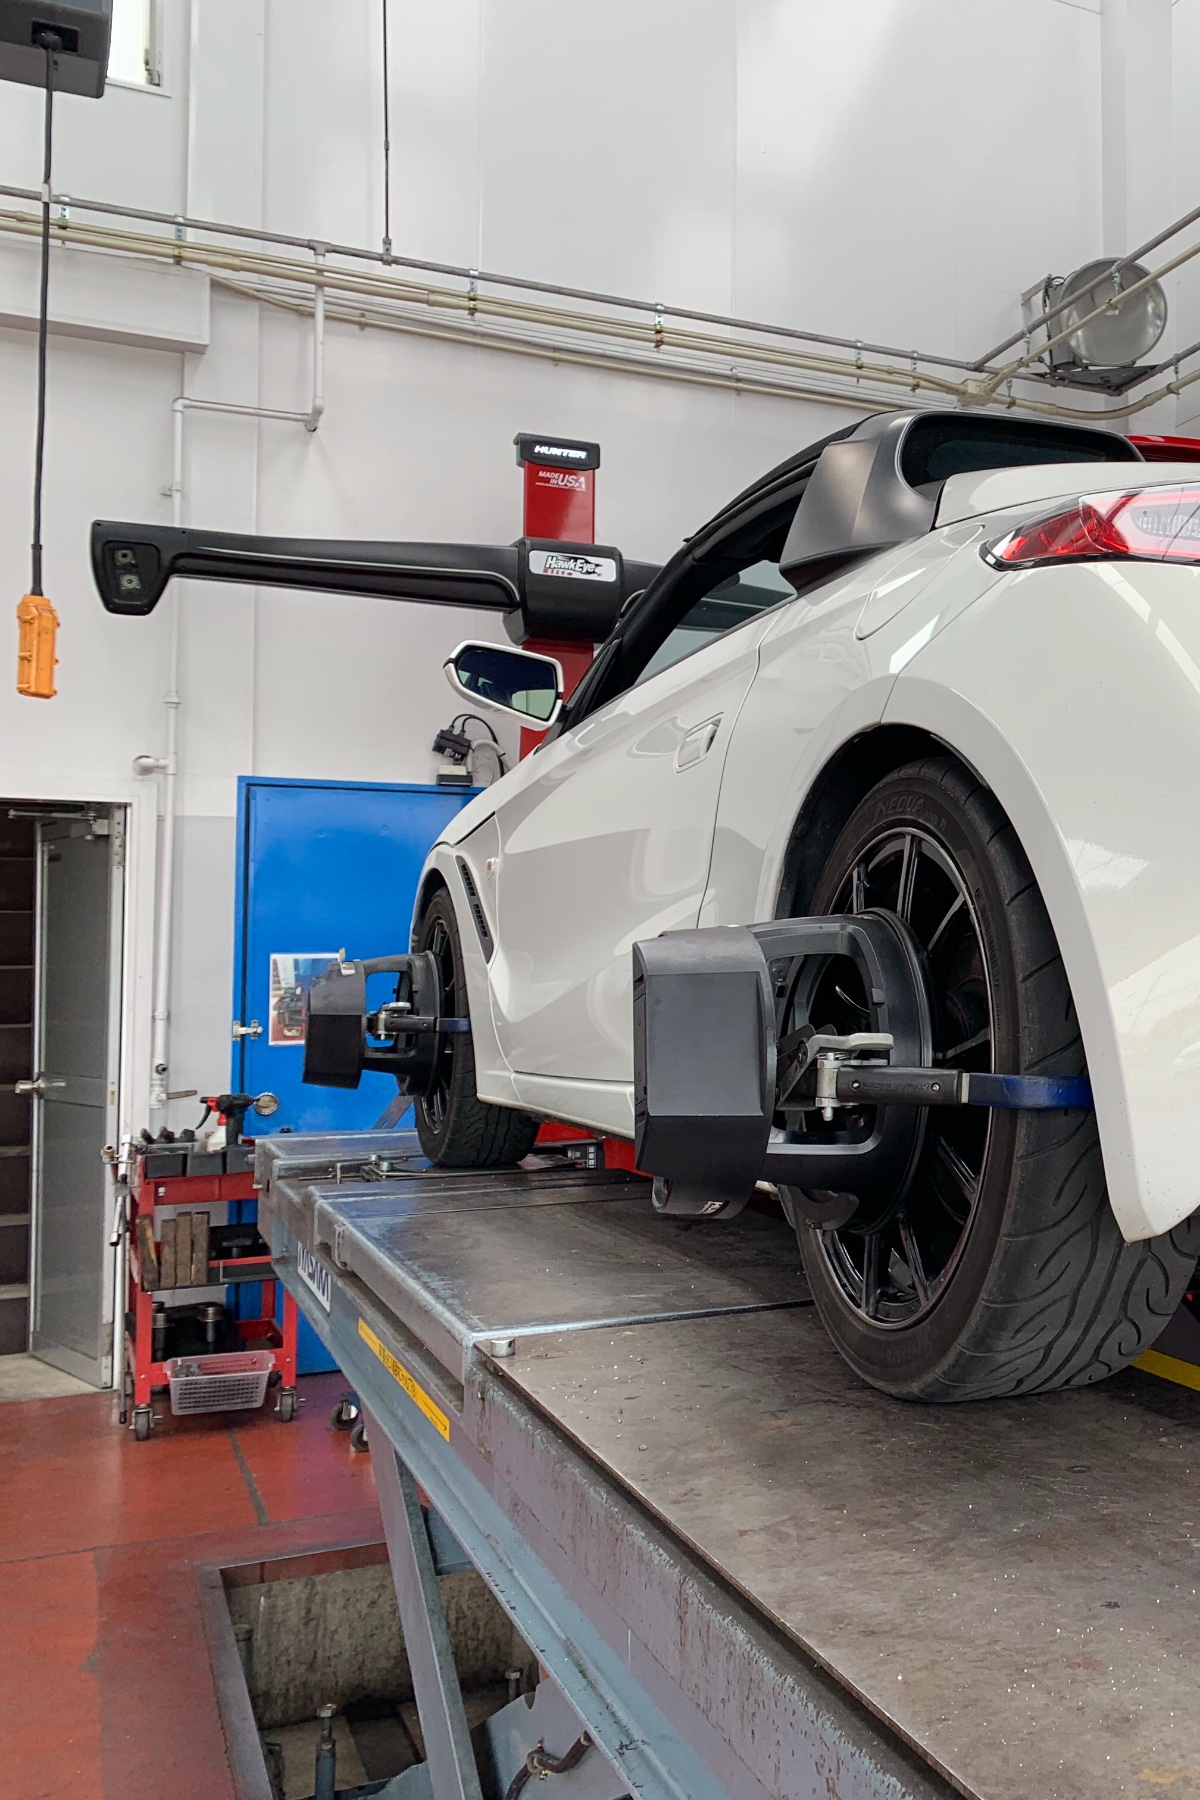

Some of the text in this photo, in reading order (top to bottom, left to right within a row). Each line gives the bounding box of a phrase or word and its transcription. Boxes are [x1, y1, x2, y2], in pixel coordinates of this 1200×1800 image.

[534, 445, 587, 459] HUNTER
[538, 471, 560, 479] MADE
[559, 474, 586, 489] USA
[544, 555, 597, 573] HawkEye
